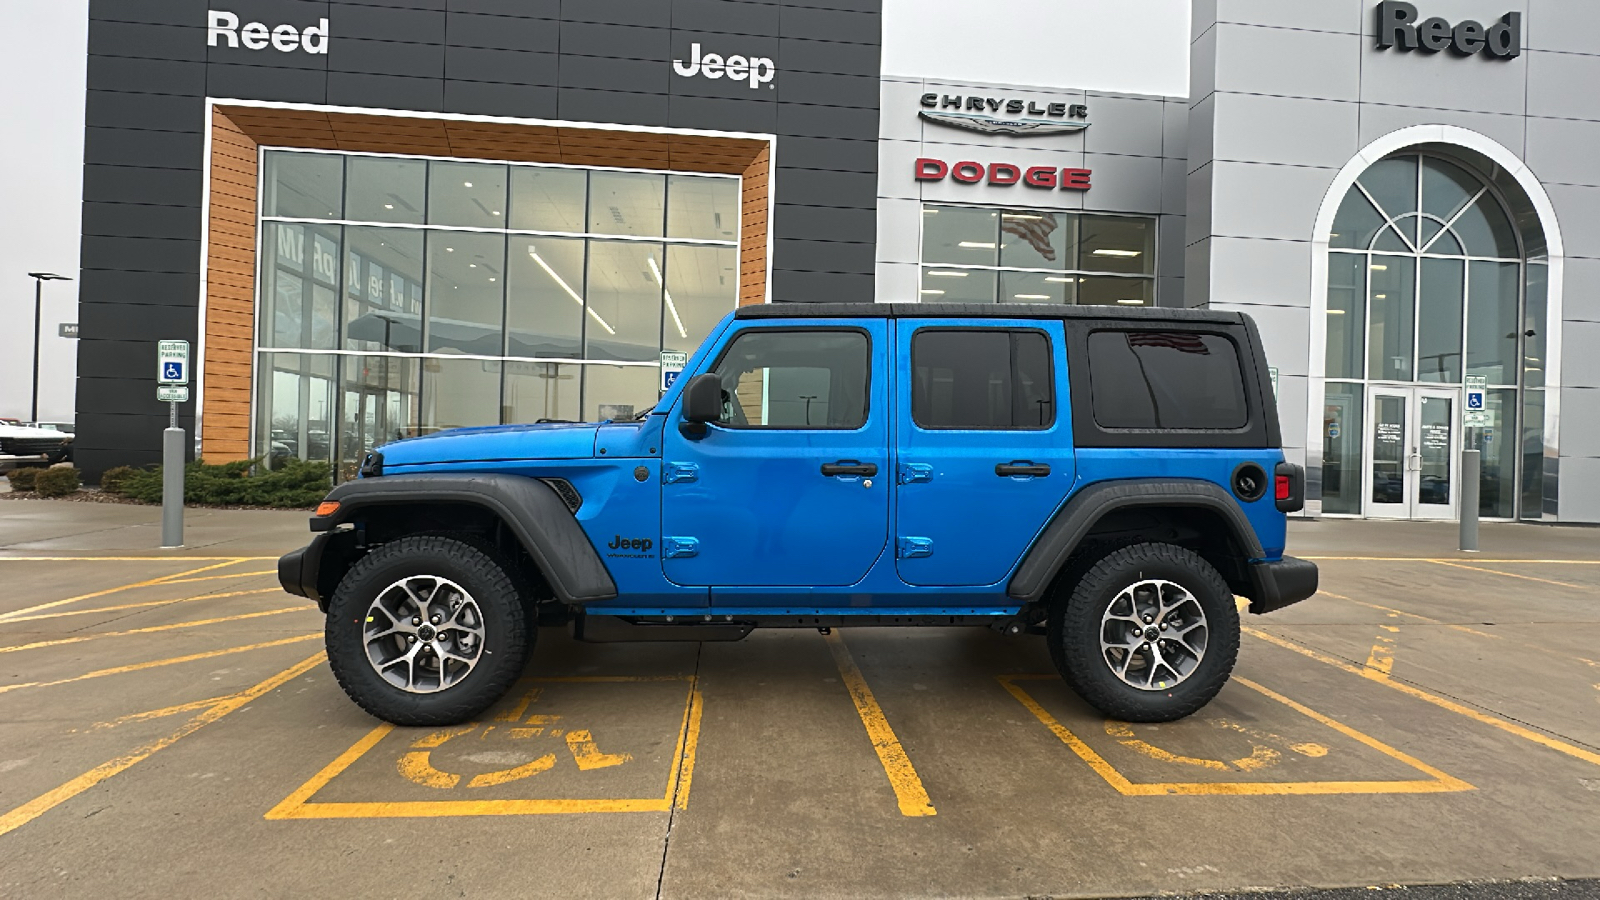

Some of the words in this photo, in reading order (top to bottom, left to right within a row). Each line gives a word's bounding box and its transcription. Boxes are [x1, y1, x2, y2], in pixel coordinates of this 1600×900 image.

[207, 10, 329, 54] Reed
[1378, 0, 1521, 58] Reed
[673, 43, 775, 89] Jeep
[920, 93, 1088, 118] CHRYSLER
[915, 158, 1092, 190] DODGE
[608, 534, 653, 552] Jeep
